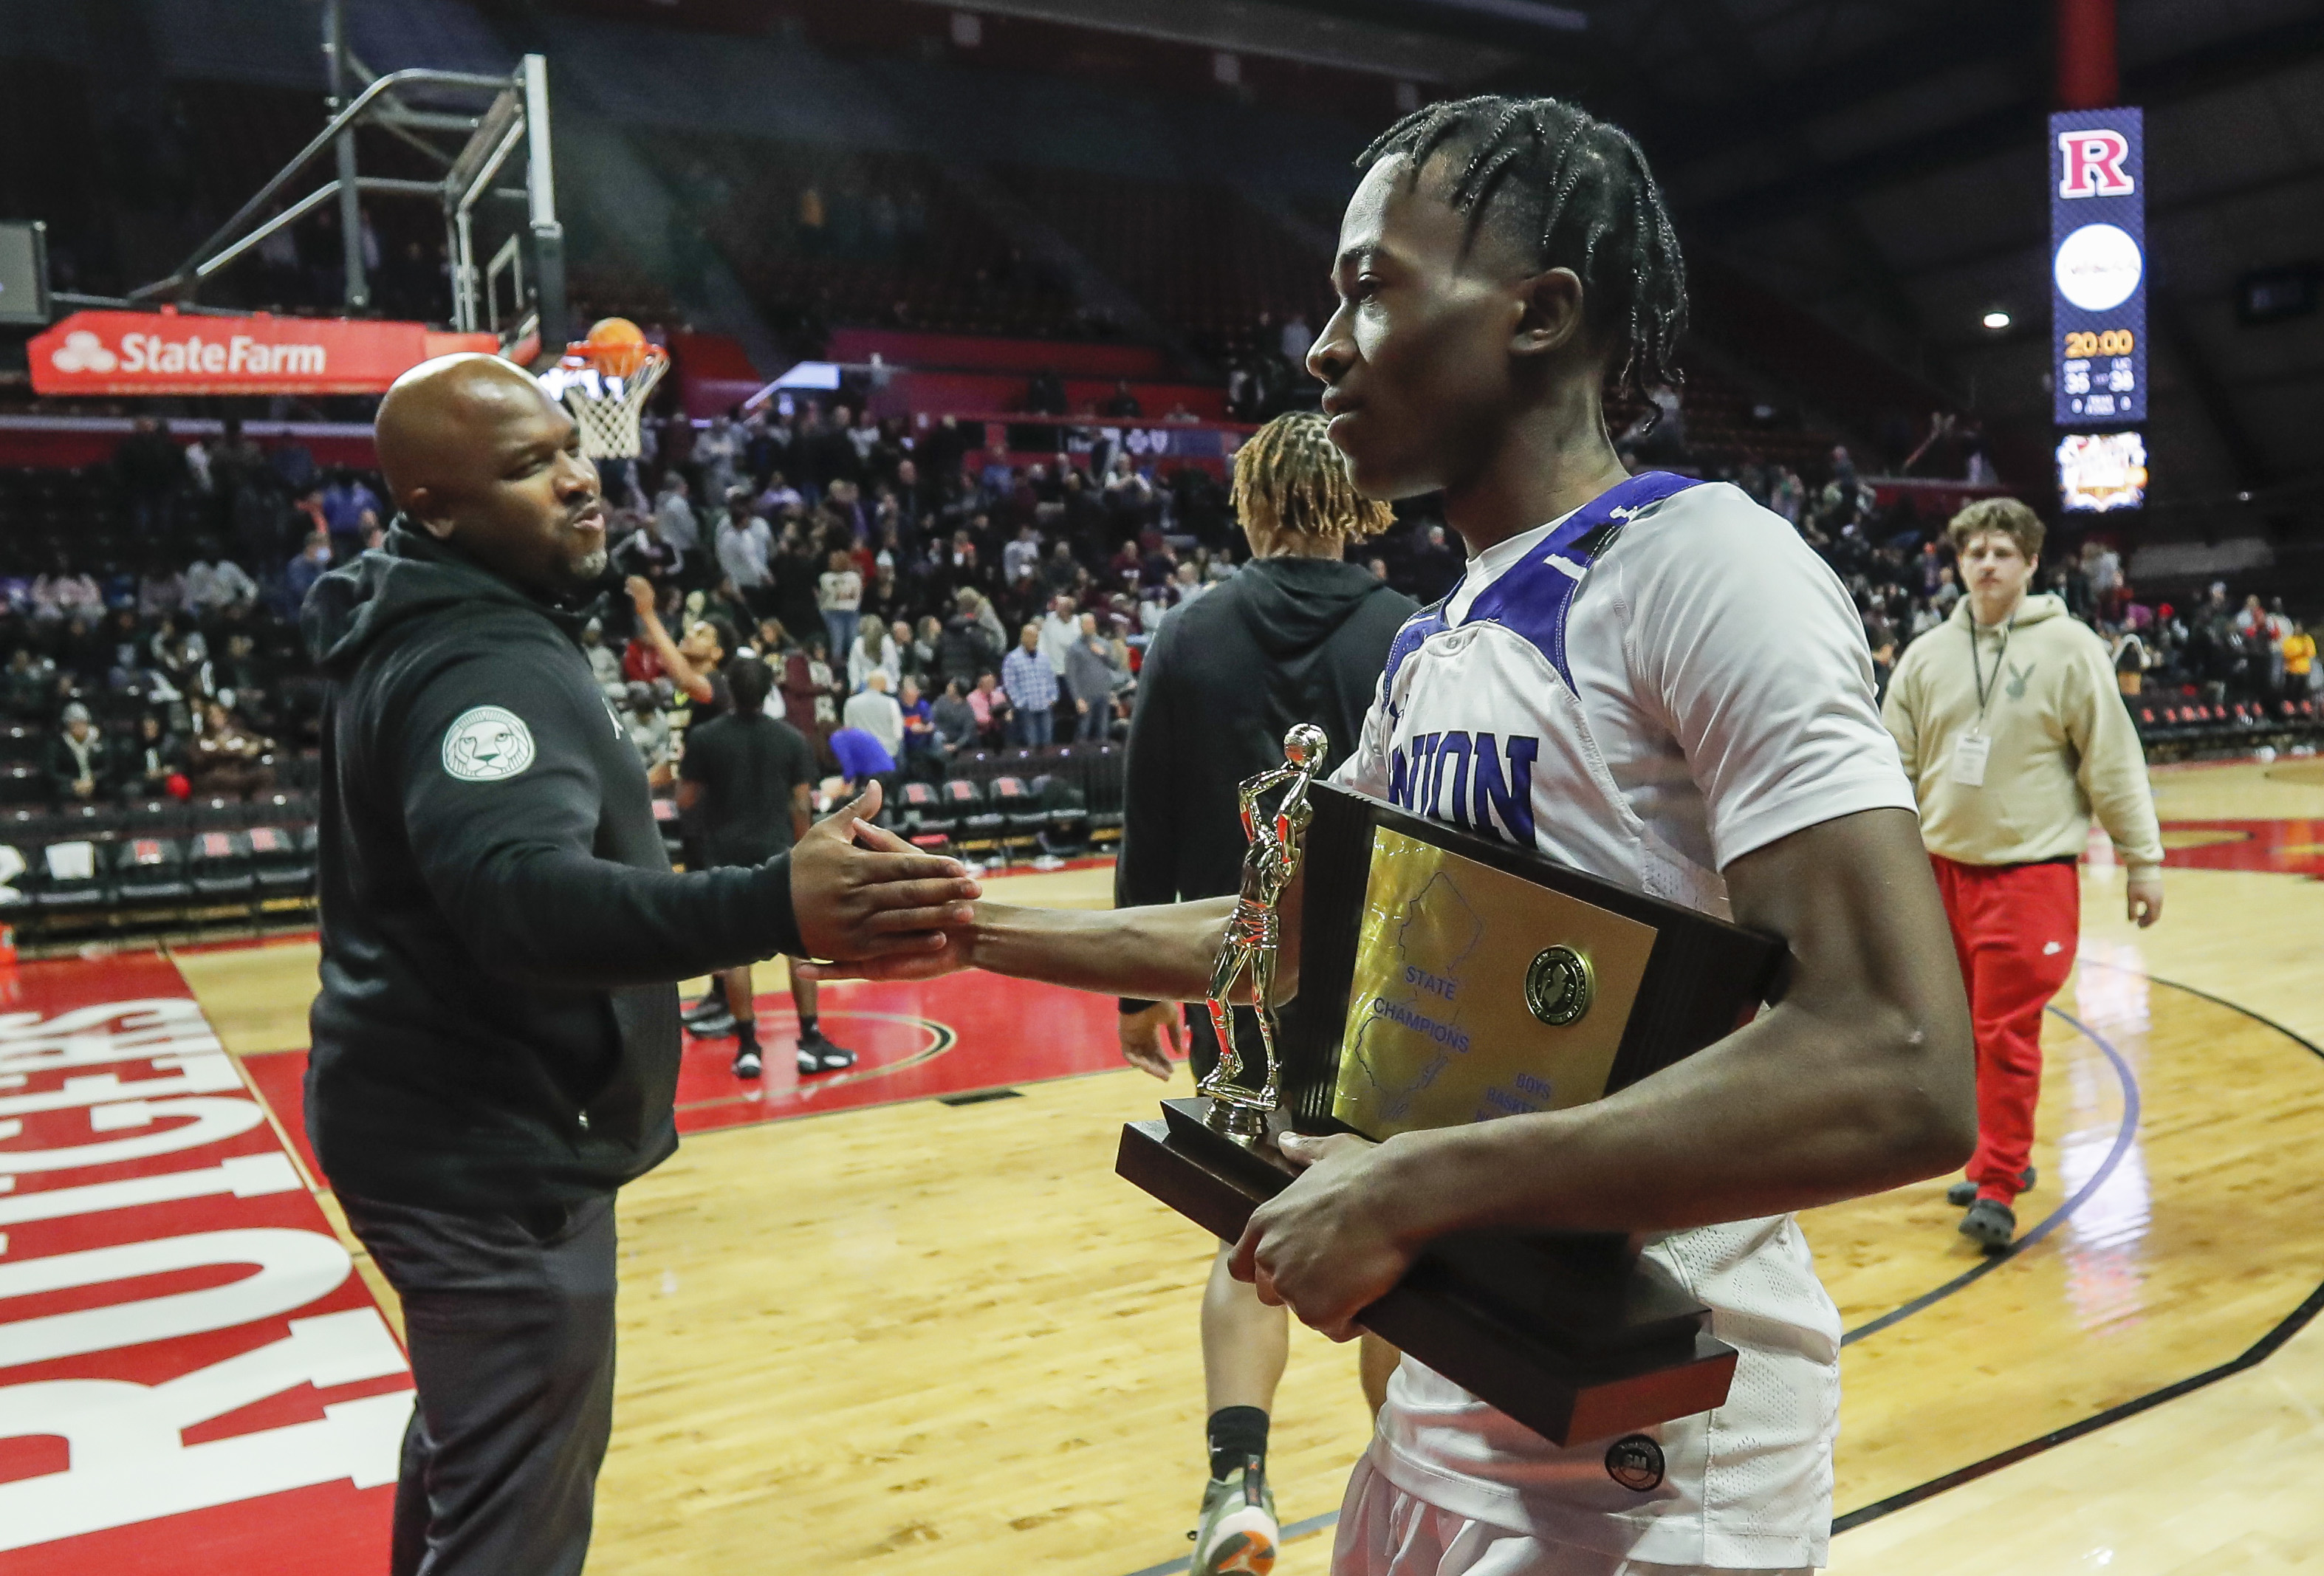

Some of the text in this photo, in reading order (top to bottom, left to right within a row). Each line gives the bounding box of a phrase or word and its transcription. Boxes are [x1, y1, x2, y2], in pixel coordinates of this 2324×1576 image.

[2057, 129, 2136, 199] R
[2063, 329, 2134, 358] 20:00
[1388, 730, 1540, 850] NION
[1405, 965, 1456, 1000] STATE
[1374, 997, 1470, 1053] CHAMPIONS
[1516, 1072, 1552, 1100] BOYS
